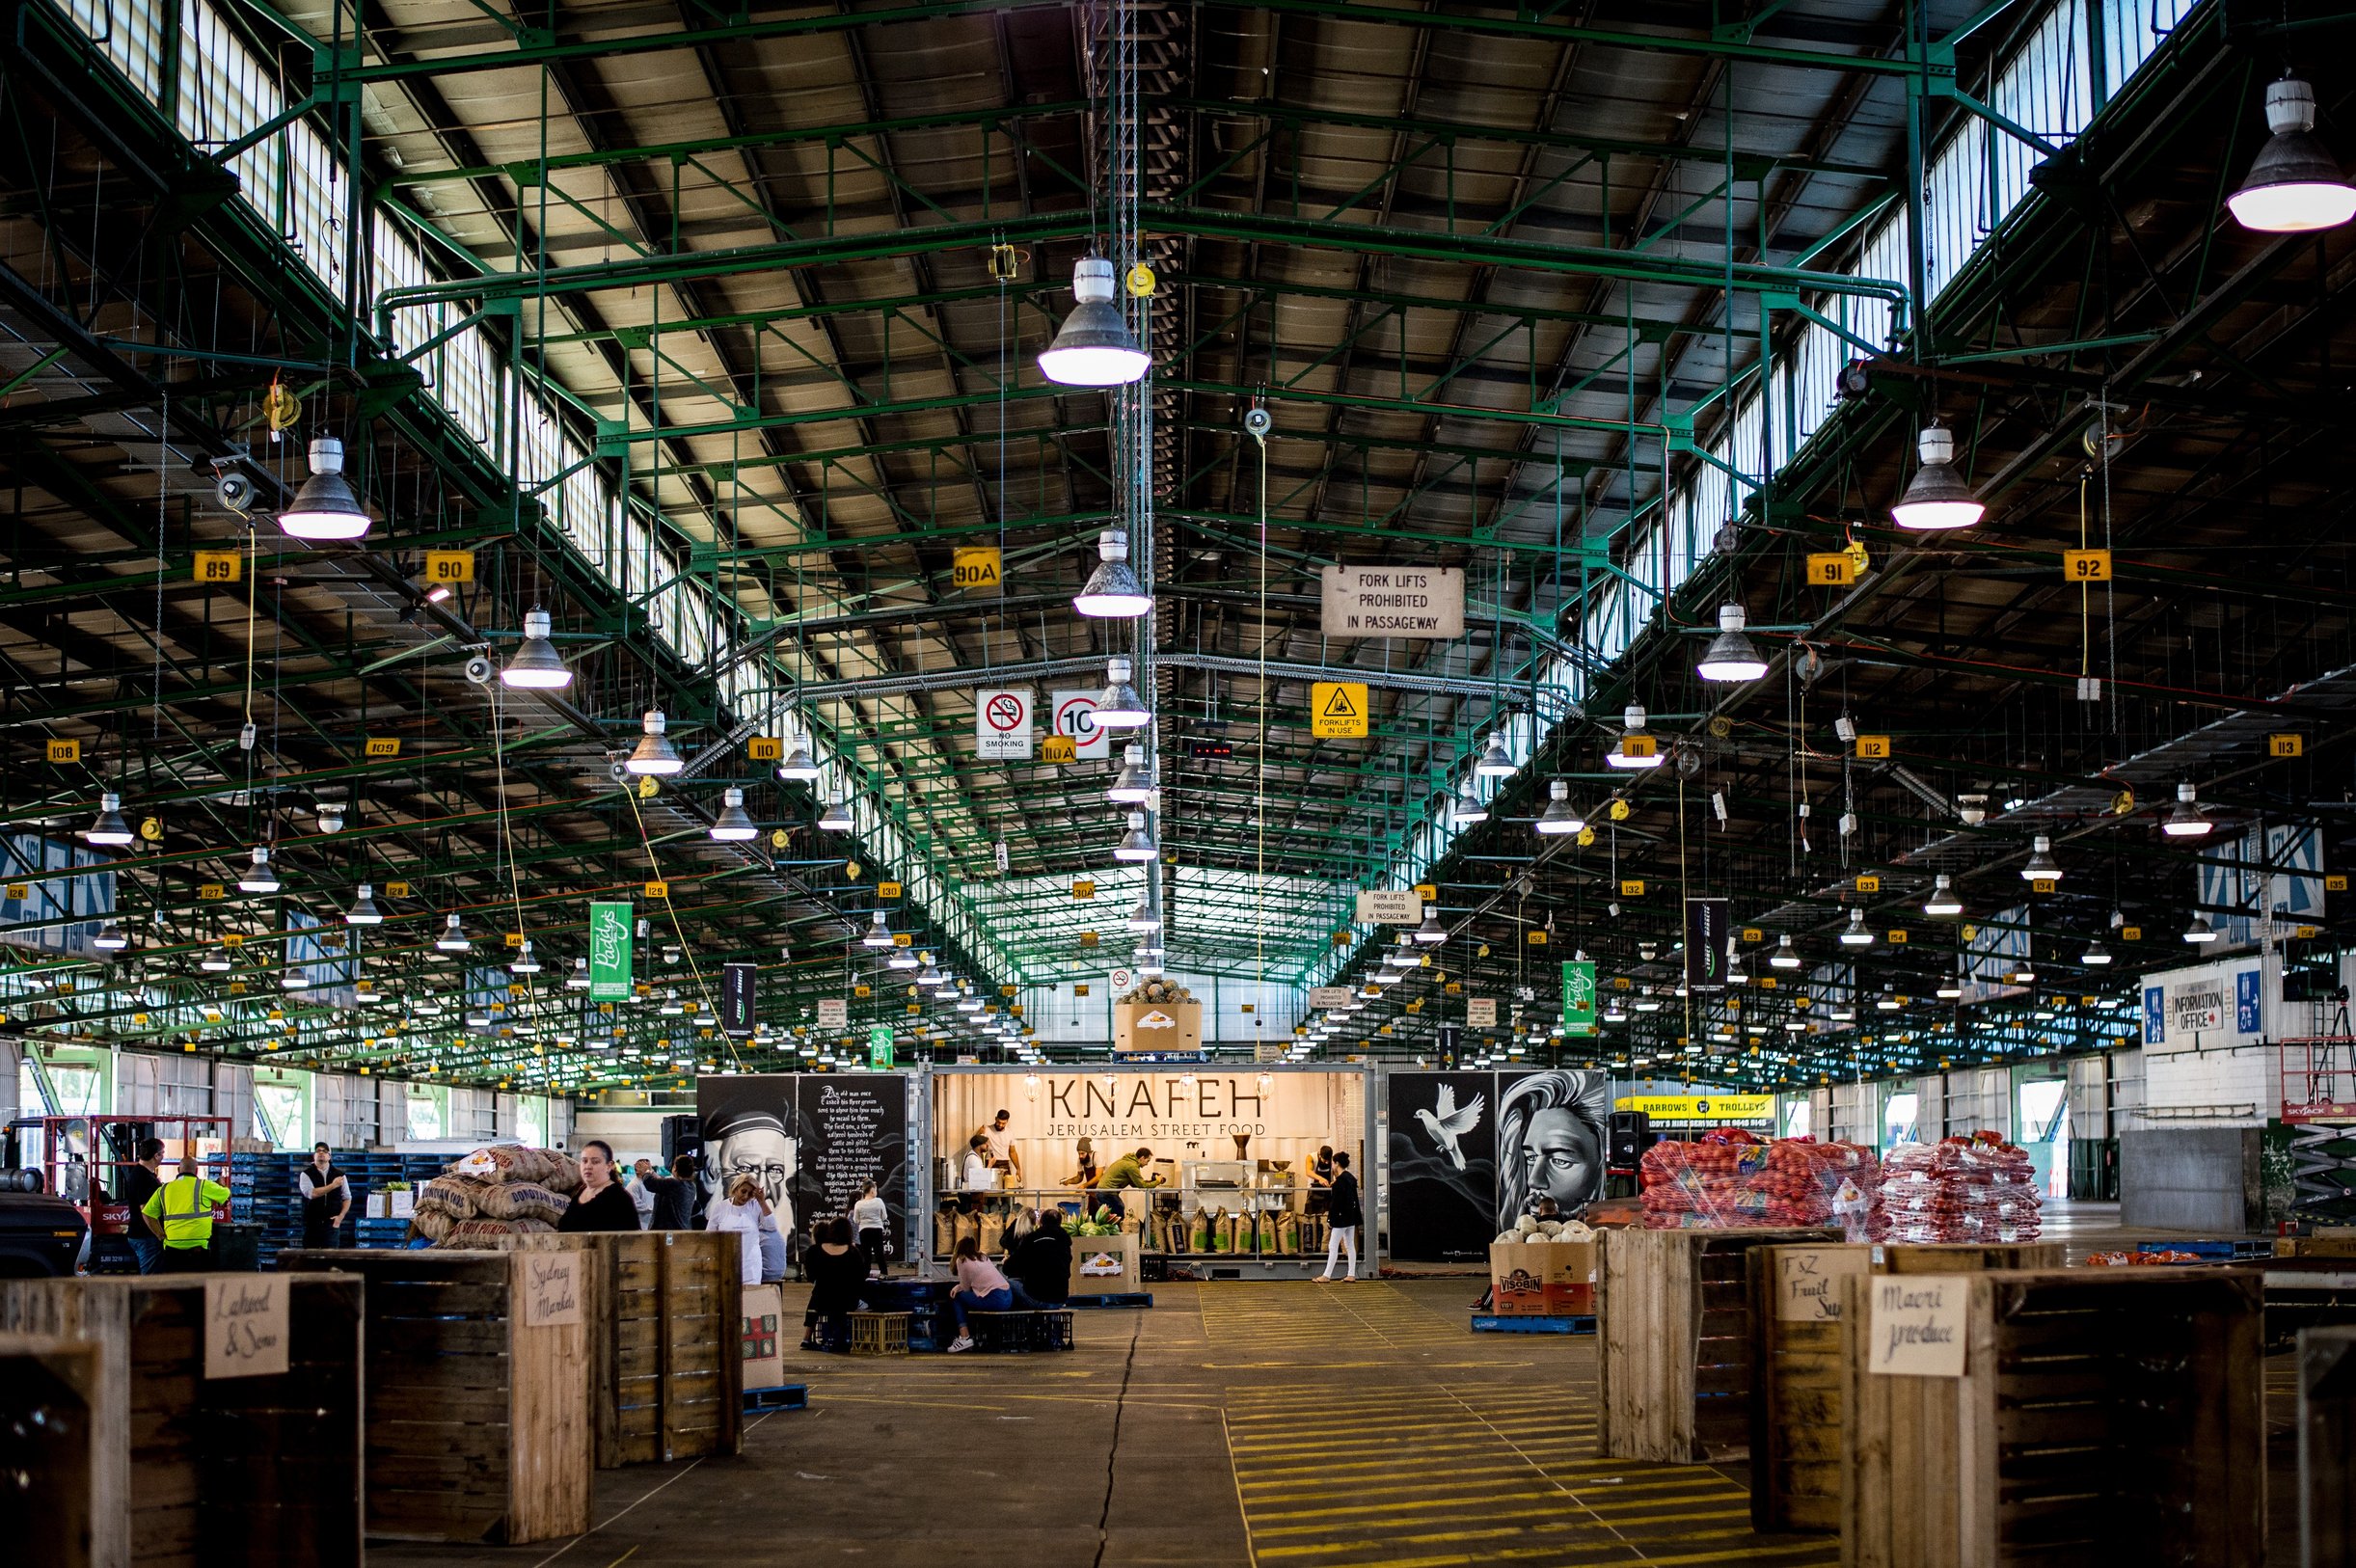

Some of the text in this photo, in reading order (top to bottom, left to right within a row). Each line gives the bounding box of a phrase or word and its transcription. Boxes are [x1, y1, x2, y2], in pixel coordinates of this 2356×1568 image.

[205, 561, 230, 579] 89
[438, 561, 463, 579] 90
[955, 563, 996, 582] 90A
[1825, 563, 1842, 581] 91
[2076, 559, 2100, 577] 92
[1359, 575, 1427, 588] FORK LIFTS
[1359, 594, 1428, 608] PROHIBITED
[1347, 615, 1439, 631] IN PASSAGEWAY
[1064, 710, 1095, 733] 10
[1318, 718, 1362, 727] FORKLIFTS
[51, 744, 74, 760] 108
[371, 743, 394, 754] 109
[756, 743, 773, 757] 110
[1632, 743, 1644, 757] 111
[1864, 743, 1882, 755] 112
[2277, 741, 2294, 755] 113
[389, 885, 404, 895] 128
[882, 886, 897, 896] 130
[1625, 884, 1640, 894] 132
[1860, 881, 1875, 890] 133
[2036, 881, 2052, 891] 134
[2329, 879, 2344, 889] 135
[9, 889, 24, 898] 126
[204, 888, 220, 898] 127
[648, 887, 663, 896] 129
[1072, 887, 1095, 898] 130A
[1421, 890, 1431, 899] 31
[595, 910, 629, 970] Paddy's
[2175, 991, 2221, 1014] INFORMATION
[2180, 1011, 2208, 1030] OFFICE
[1048, 1079, 1261, 1119] KNAFEH
[1642, 1102, 1766, 1112] BARROWS TROLLEYS
[2288, 1106, 2325, 1116] SKYJACK
[1047, 1123, 1265, 1136] JERUSALEM STREET FOOD
[2306, 1194, 2330, 1203] SKYJACK
[102, 1209, 131, 1222] SKYJ
[530, 1258, 570, 1296] Sydney
[1501, 1277, 1542, 1293] VISOBIN
[1791, 1278, 1828, 1300] Fruit
[534, 1293, 576, 1321] Markets
[225, 1321, 238, 1357] &
[1882, 1316, 1954, 1364] produce
